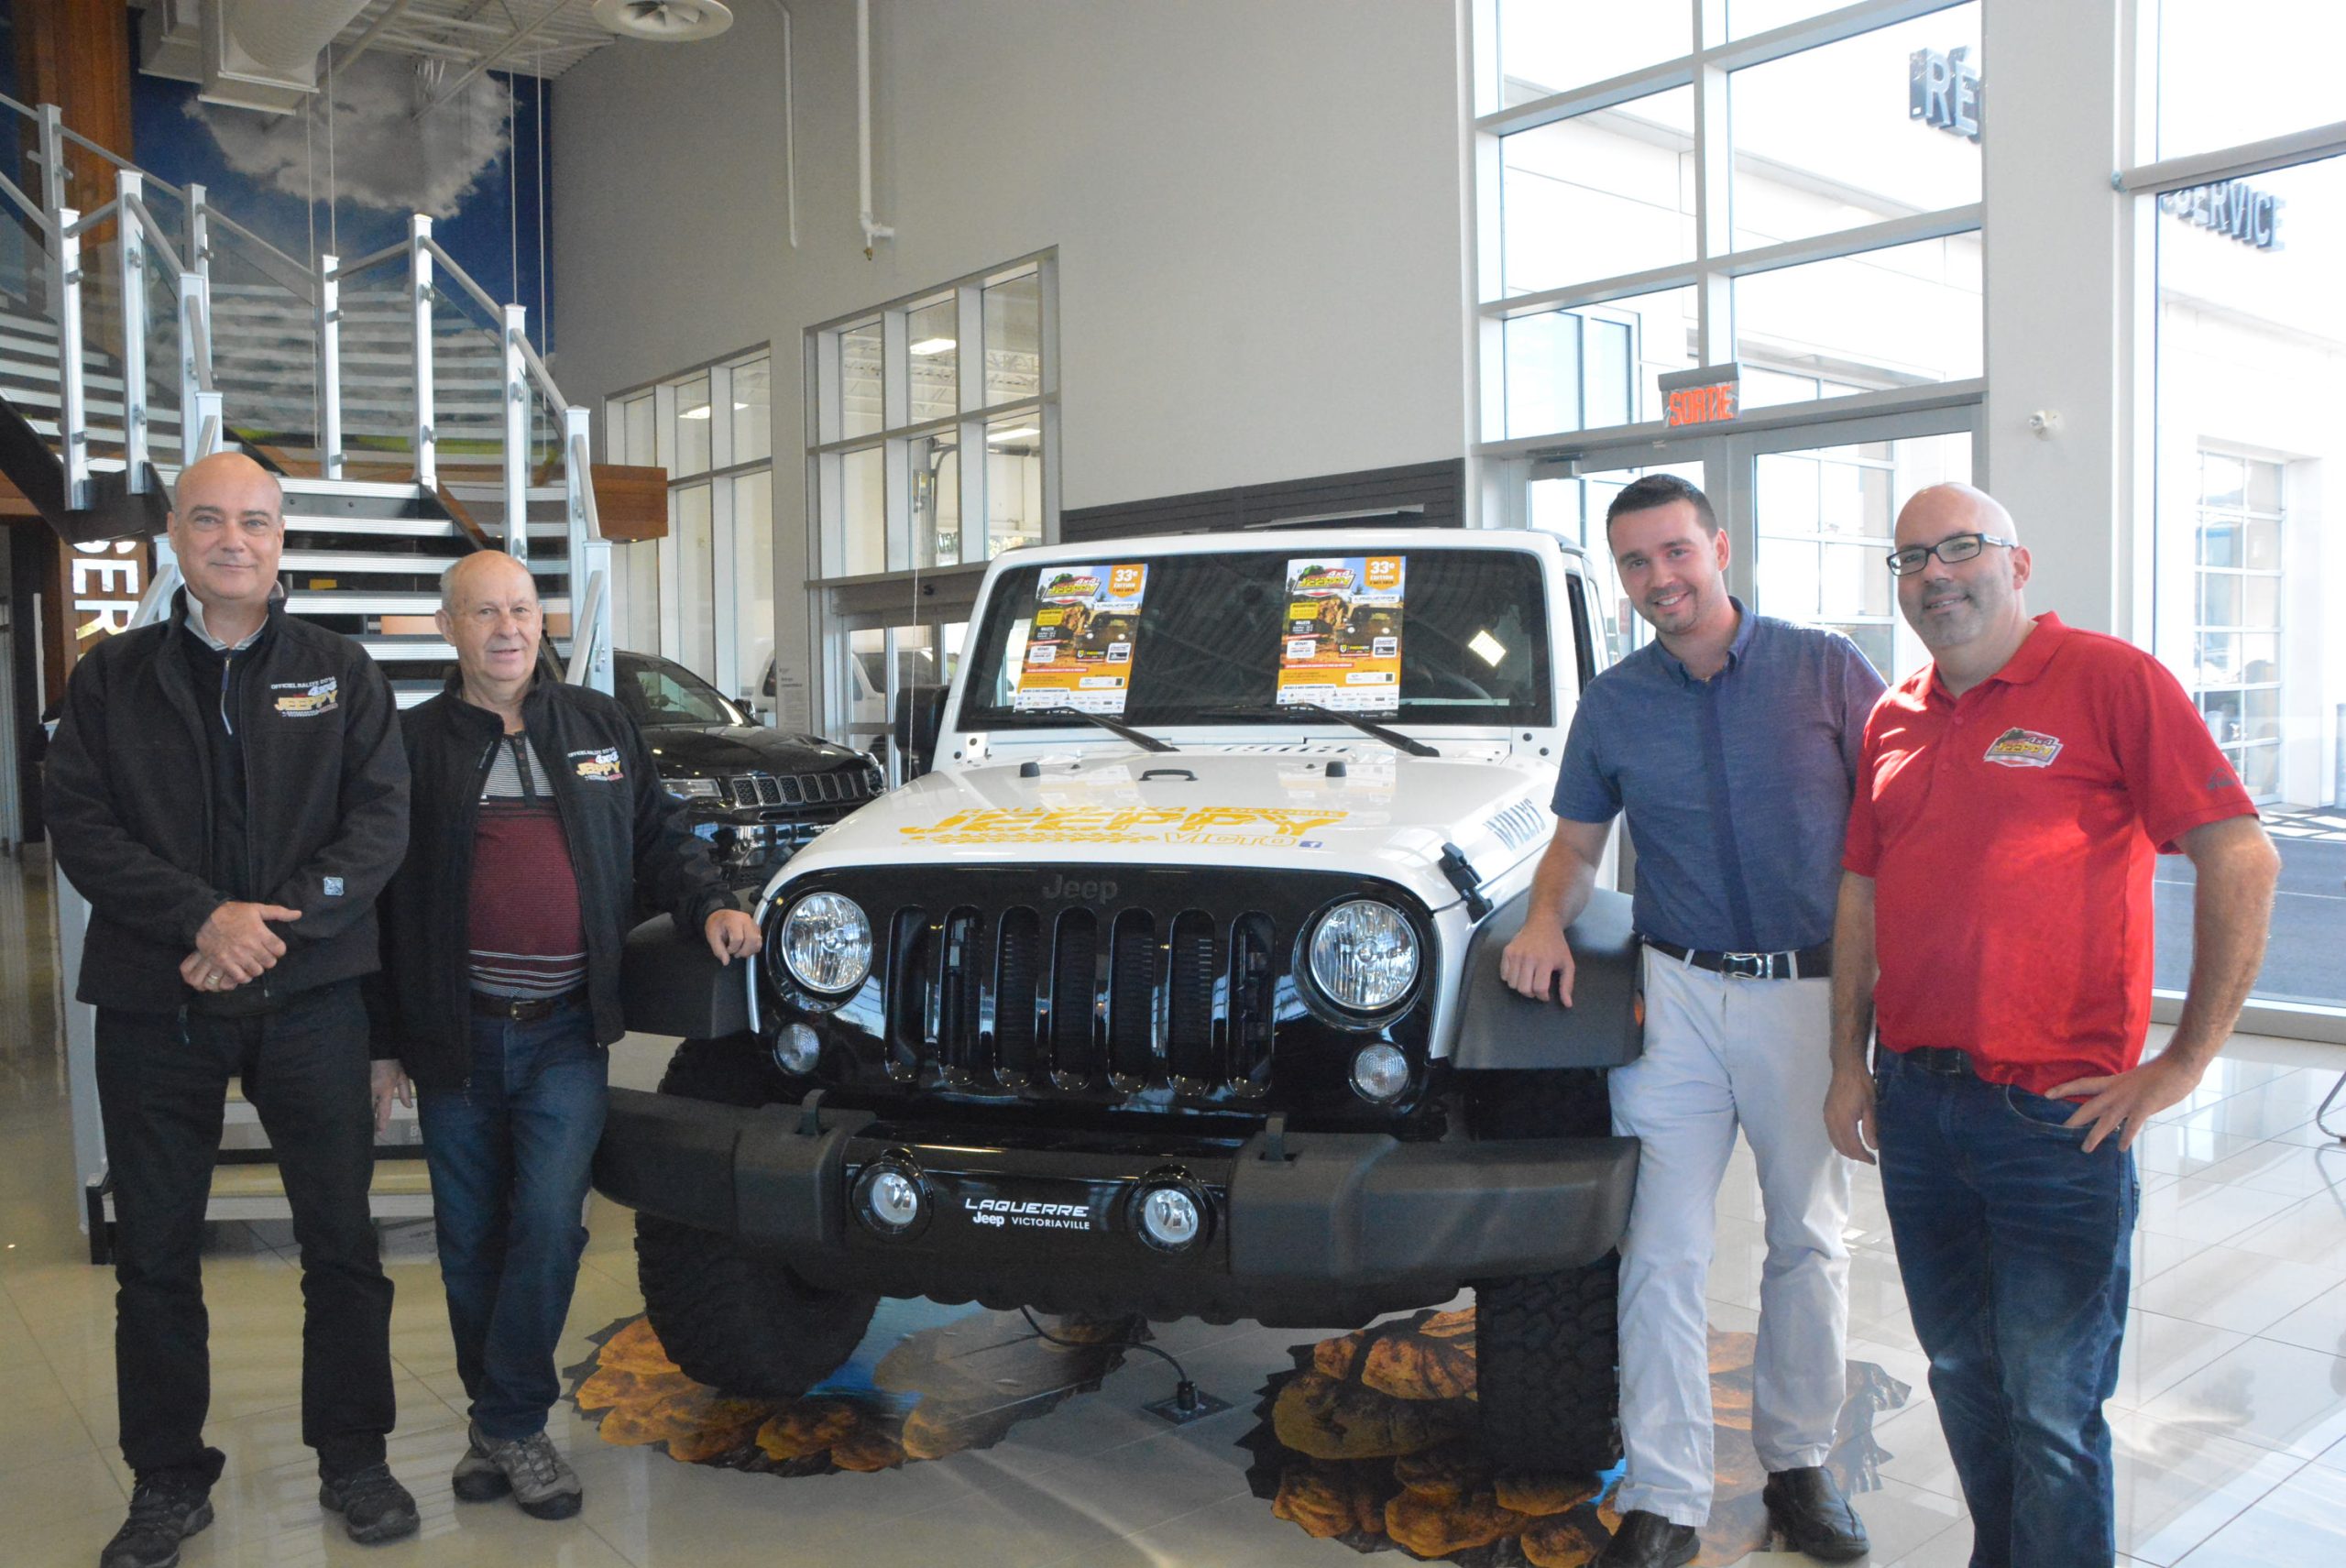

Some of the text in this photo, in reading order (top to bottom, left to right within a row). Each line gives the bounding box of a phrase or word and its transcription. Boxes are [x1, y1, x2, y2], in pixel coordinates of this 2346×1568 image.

[1910, 45, 1981, 144] RÉ
[1669, 385, 1734, 426] SORTIE
[297, 680, 320, 688] RALLYE
[274, 690, 338, 711] JEEPPY
[899, 811, 1344, 836] JEEPPY
[1164, 831, 1298, 847] VICTO
[1042, 873, 1118, 905] Jeep
[972, 1212, 1091, 1230] Jeep VICTORIAVILLE
